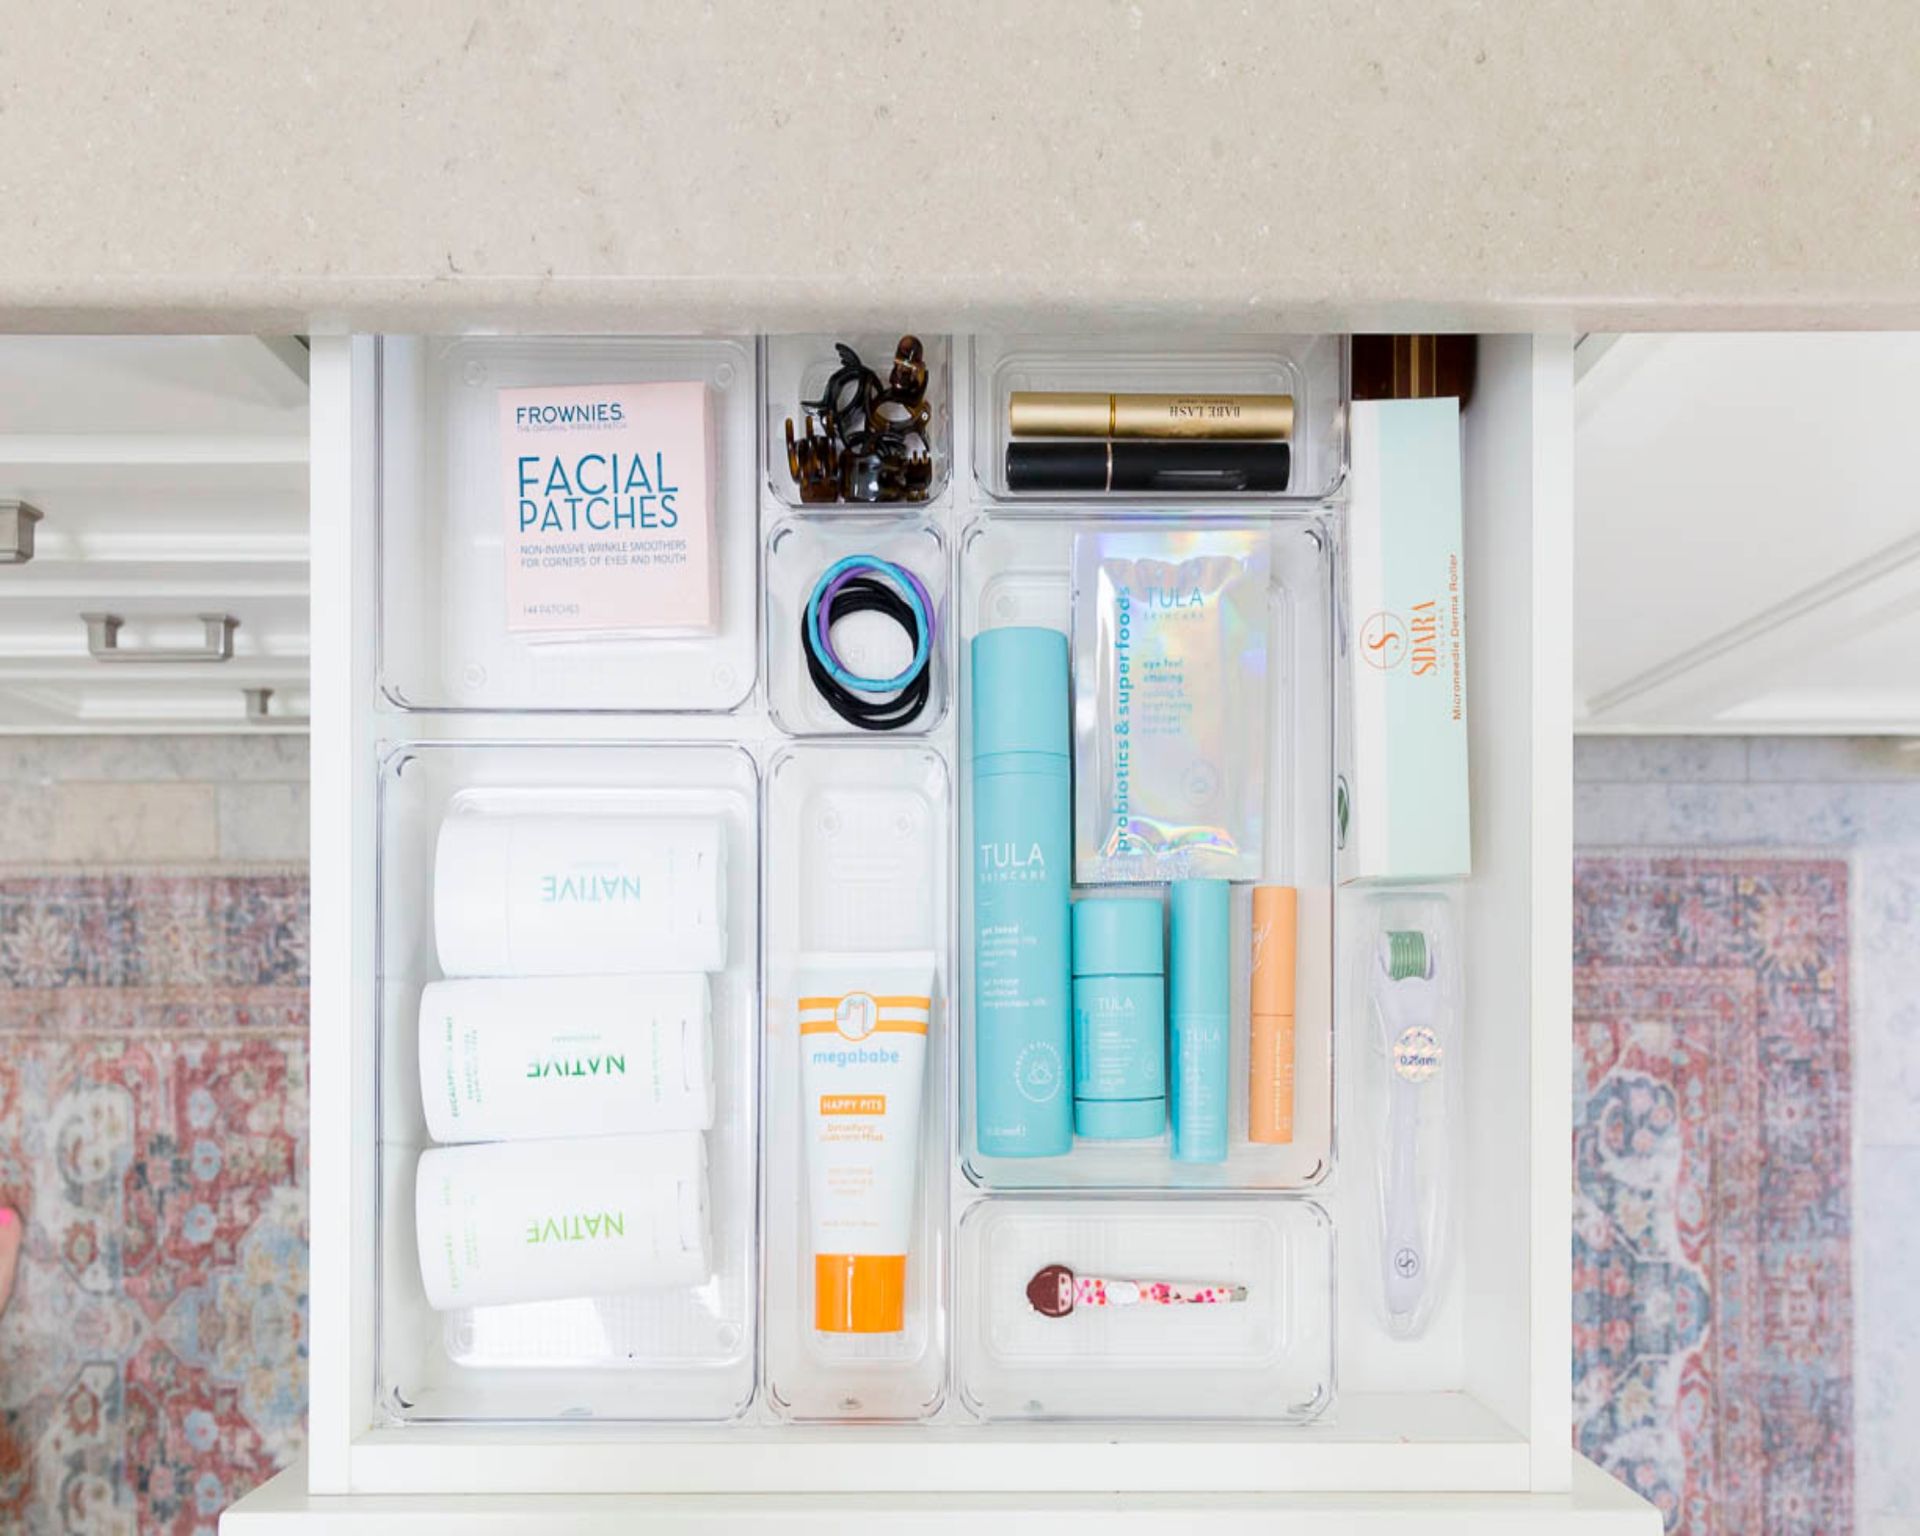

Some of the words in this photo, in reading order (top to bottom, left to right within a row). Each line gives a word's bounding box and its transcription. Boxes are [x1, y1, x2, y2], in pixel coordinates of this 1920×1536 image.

[516, 403, 623, 425] FROWNIES
[1169, 405, 1204, 417] LASH
[1208, 405, 1241, 417] BABE
[517, 451, 679, 498] FACIAL
[519, 494, 679, 533] PATCHES
[519, 542, 585, 556] NON-INVASIVE
[587, 542, 628, 554] WRINKLE
[629, 539, 687, 553] SMOOTHERS
[520, 556, 540, 569] FOR
[542, 556, 587, 568] CORNERS
[589, 555, 601, 566] OF
[604, 554, 629, 566] EYES
[630, 554, 651, 566] AND
[653, 552, 687, 565] MOUTH
[1449, 554, 1459, 592] Roller
[1145, 586, 1205, 609] TULA
[1450, 595, 1460, 638] Derma
[1114, 586, 1134, 718] superfoods
[1411, 600, 1438, 677] SDARA
[1451, 640, 1462, 721] Microneedle
[1114, 722, 1130, 736] &
[1114, 738, 1132, 852] probiotics
[980, 842, 1045, 869] TULA
[541, 875, 641, 902] NATIVE
[526, 1054, 625, 1078] NATIVE
[812, 1047, 900, 1068] megababe
[822, 1099, 858, 1111] HAPPY
[860, 1098, 883, 1111] PITS
[526, 1212, 624, 1244] NATIVE
